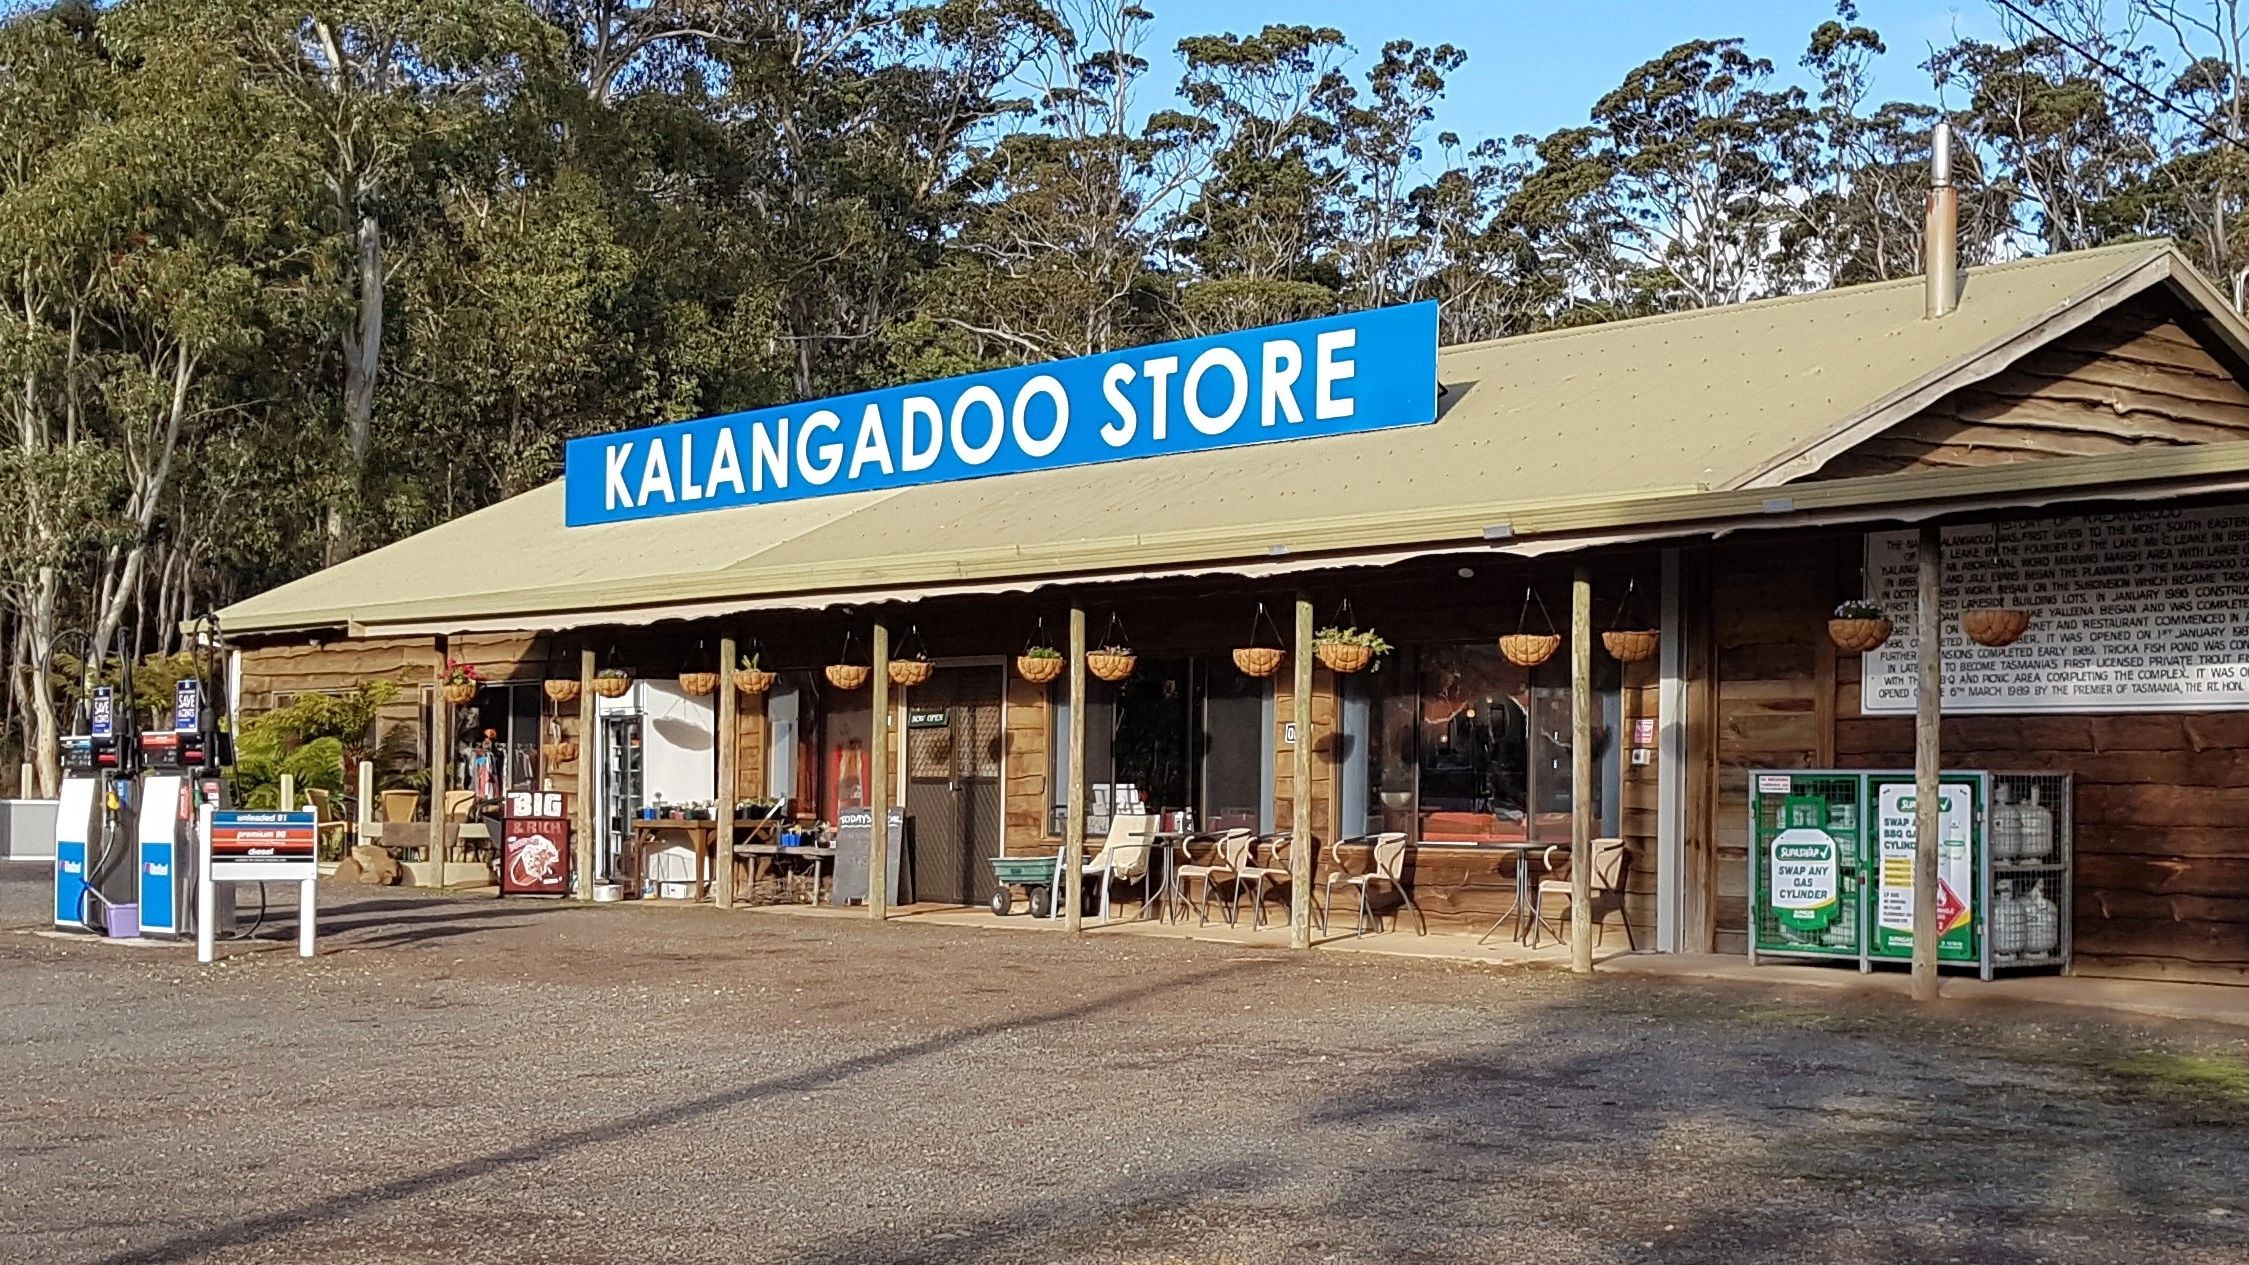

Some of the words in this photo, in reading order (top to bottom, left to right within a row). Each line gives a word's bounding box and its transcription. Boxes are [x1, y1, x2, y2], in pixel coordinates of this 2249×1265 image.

[604, 375, 1069, 511] KALANGADOO
[1100, 327, 1357, 448] STORE
[2111, 590, 2161, 602] JANUARY
[2100, 603, 2137, 615] BEGAN
[2142, 602, 2166, 612] AND
[2170, 601, 2193, 612] WAS
[2055, 619, 2079, 631] AND
[2083, 616, 2151, 630] RESTAURANT
[2155, 613, 2226, 626] COMMENCED
[2230, 612, 2240, 623] IN
[2046, 633, 2056, 643] IT
[2059, 632, 2083, 643] WAS
[2089, 630, 2131, 642] OPENED
[2136, 630, 2151, 641] ON
[2174, 626, 2226, 639] JANUARY
[1880, 650, 1918, 661] FURTHER
[1977, 647, 2034, 659] COMPLETED
[2038, 646, 2068, 657] EARLY
[2102, 643, 2139, 655] TRICKA
[2143, 642, 2167, 653] FISH
[2170, 641, 2199, 652] POND
[2203, 640, 2227, 651] WAS
[1887, 663, 1896, 674] IN
[1944, 662, 1957, 672] TO
[1960, 660, 1996, 672] BECOME
[2063, 657, 2093, 669] FIRST
[2096, 656, 2144, 668] LICENSED
[2149, 654, 2193, 667] PRIVATE
[2198, 653, 2232, 665] TROUT
[1883, 675, 1905, 685] WITH
[1960, 672, 1980, 684] AND
[1983, 672, 2010, 684] PICNIC
[2013, 671, 2042, 683] AREA
[2046, 670, 2109, 683] COMPLETING
[2113, 669, 2135, 681] THE
[2195, 668, 2206, 678] IT
[2210, 666, 2235, 678] WAS
[1878, 688, 1910, 699] OPENED
[1968, 685, 2002, 697] MARCH
[2034, 684, 2049, 696] BY
[2051, 684, 2071, 695] THE
[2073, 683, 2113, 696] PREMIER
[2115, 683, 2128, 694] OF
[2185, 681, 2203, 692] THE
[507, 792, 563, 817] BIG
[513, 820, 525, 834] &
[526, 820, 562, 835] RICH
[1884, 818, 1910, 827] SWAP
[1778, 866, 1806, 876] SWAP
[1808, 866, 1829, 876] ANY
[1793, 877, 1814, 888] GAS
[1779, 889, 1828, 899] CYLINDER
